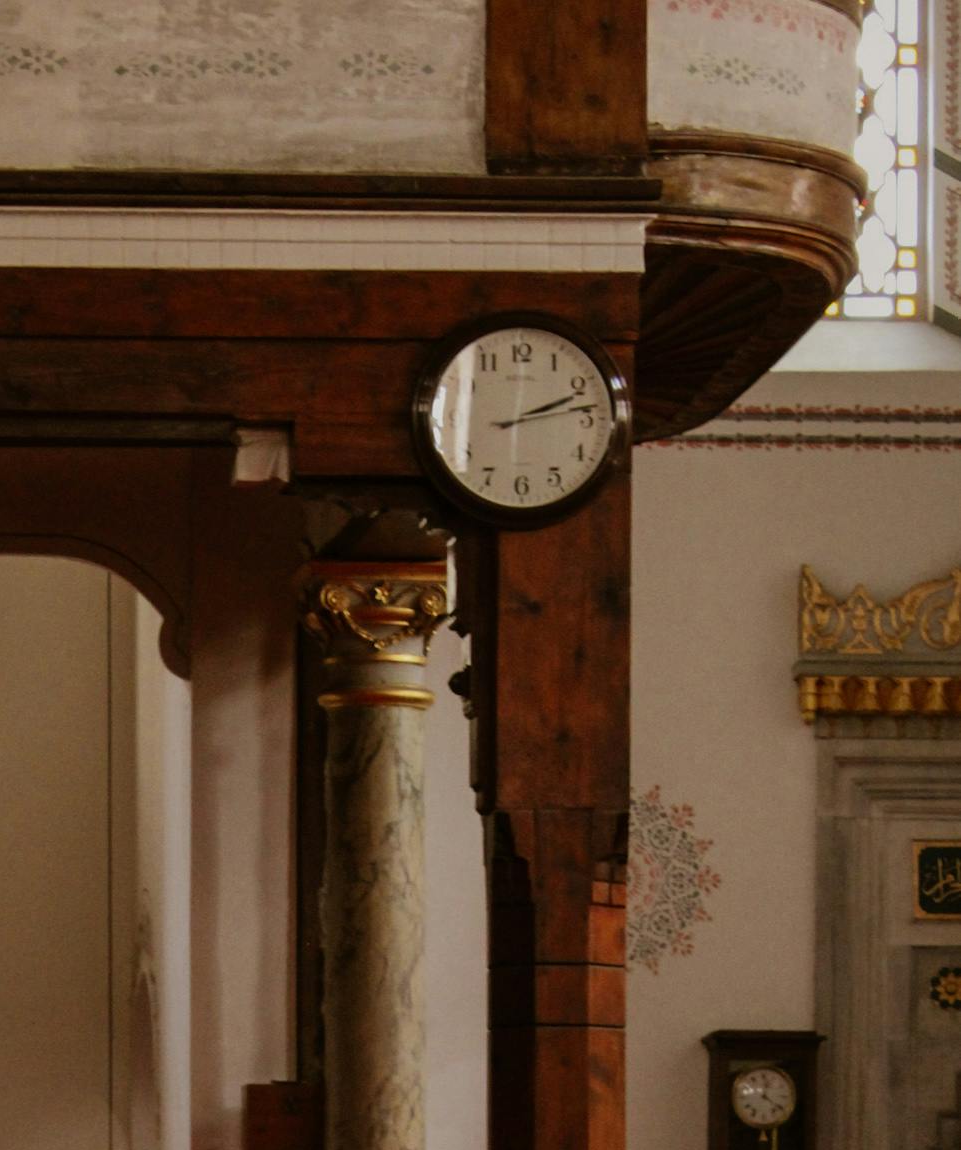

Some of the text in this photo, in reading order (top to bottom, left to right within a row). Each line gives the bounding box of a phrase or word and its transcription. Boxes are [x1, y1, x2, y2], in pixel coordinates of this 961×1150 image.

[481, 353, 497, 372] 11
[512, 343, 532, 363] 12
[551, 353, 558, 372] 1
[571, 376, 586, 396] 2
[580, 406, 594, 429] 3
[571, 444, 584, 462] 4
[482, 467, 496, 487] 7
[514, 475, 530, 496] 6
[547, 467, 562, 488] 5
